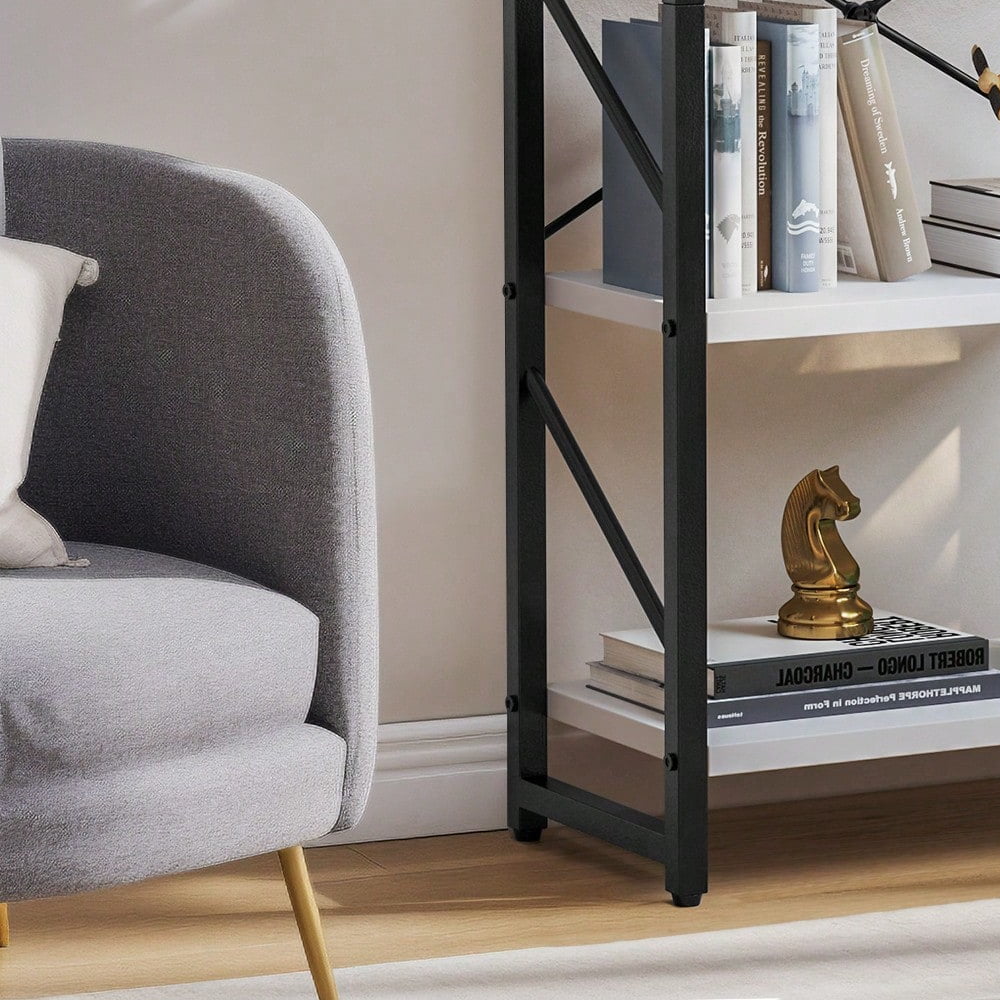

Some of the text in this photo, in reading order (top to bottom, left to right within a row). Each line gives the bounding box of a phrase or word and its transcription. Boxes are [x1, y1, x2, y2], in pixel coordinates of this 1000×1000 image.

[758, 54, 766, 111] REVEALING
[860, 58, 888, 154] Dreaming of Sweden
[758, 131, 768, 196] Revolution
[896, 208, 912, 263] Andrew Brown
